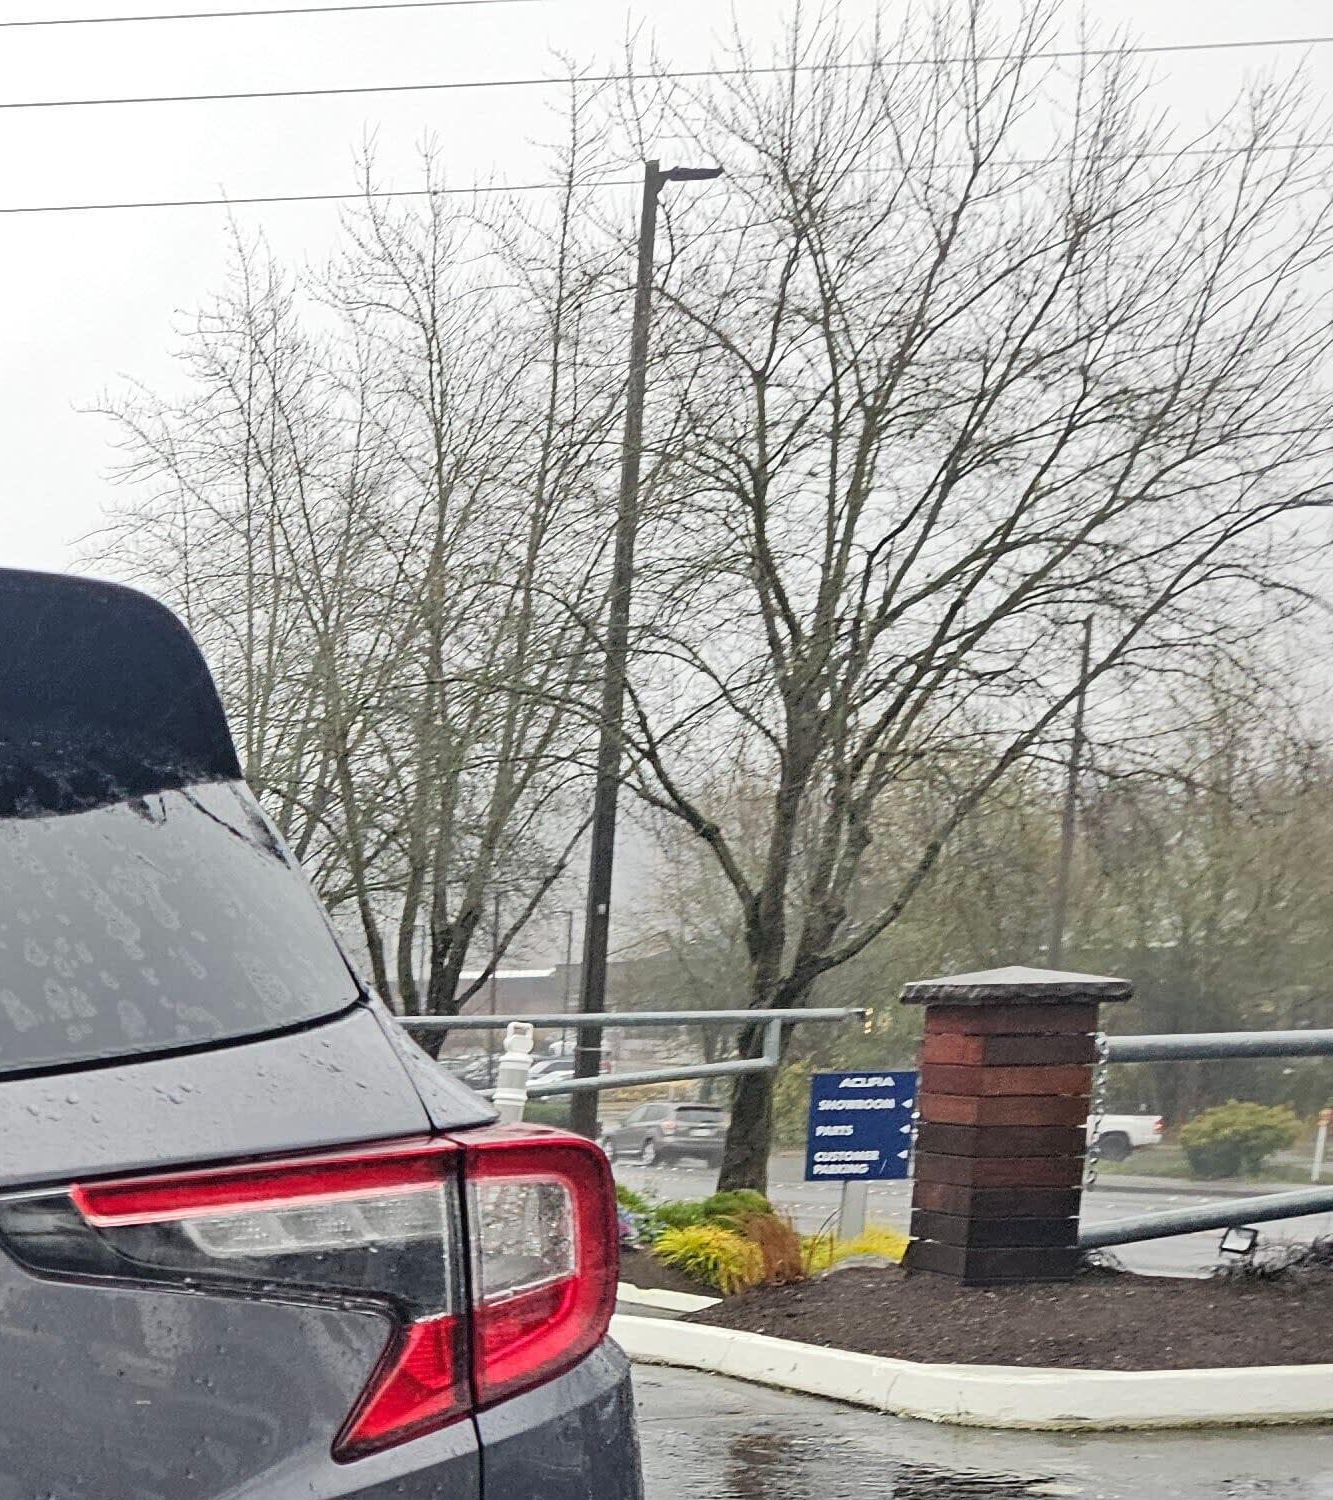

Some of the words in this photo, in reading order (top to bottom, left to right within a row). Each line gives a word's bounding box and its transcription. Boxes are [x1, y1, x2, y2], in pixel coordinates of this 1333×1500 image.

[838, 1076, 896, 1088] ACURA
[818, 1098, 896, 1110] SHOWROOM
[815, 1125, 854, 1136] PARTS
[813, 1150, 880, 1162] CUSTOMER
[812, 1163, 870, 1175] PARKING
